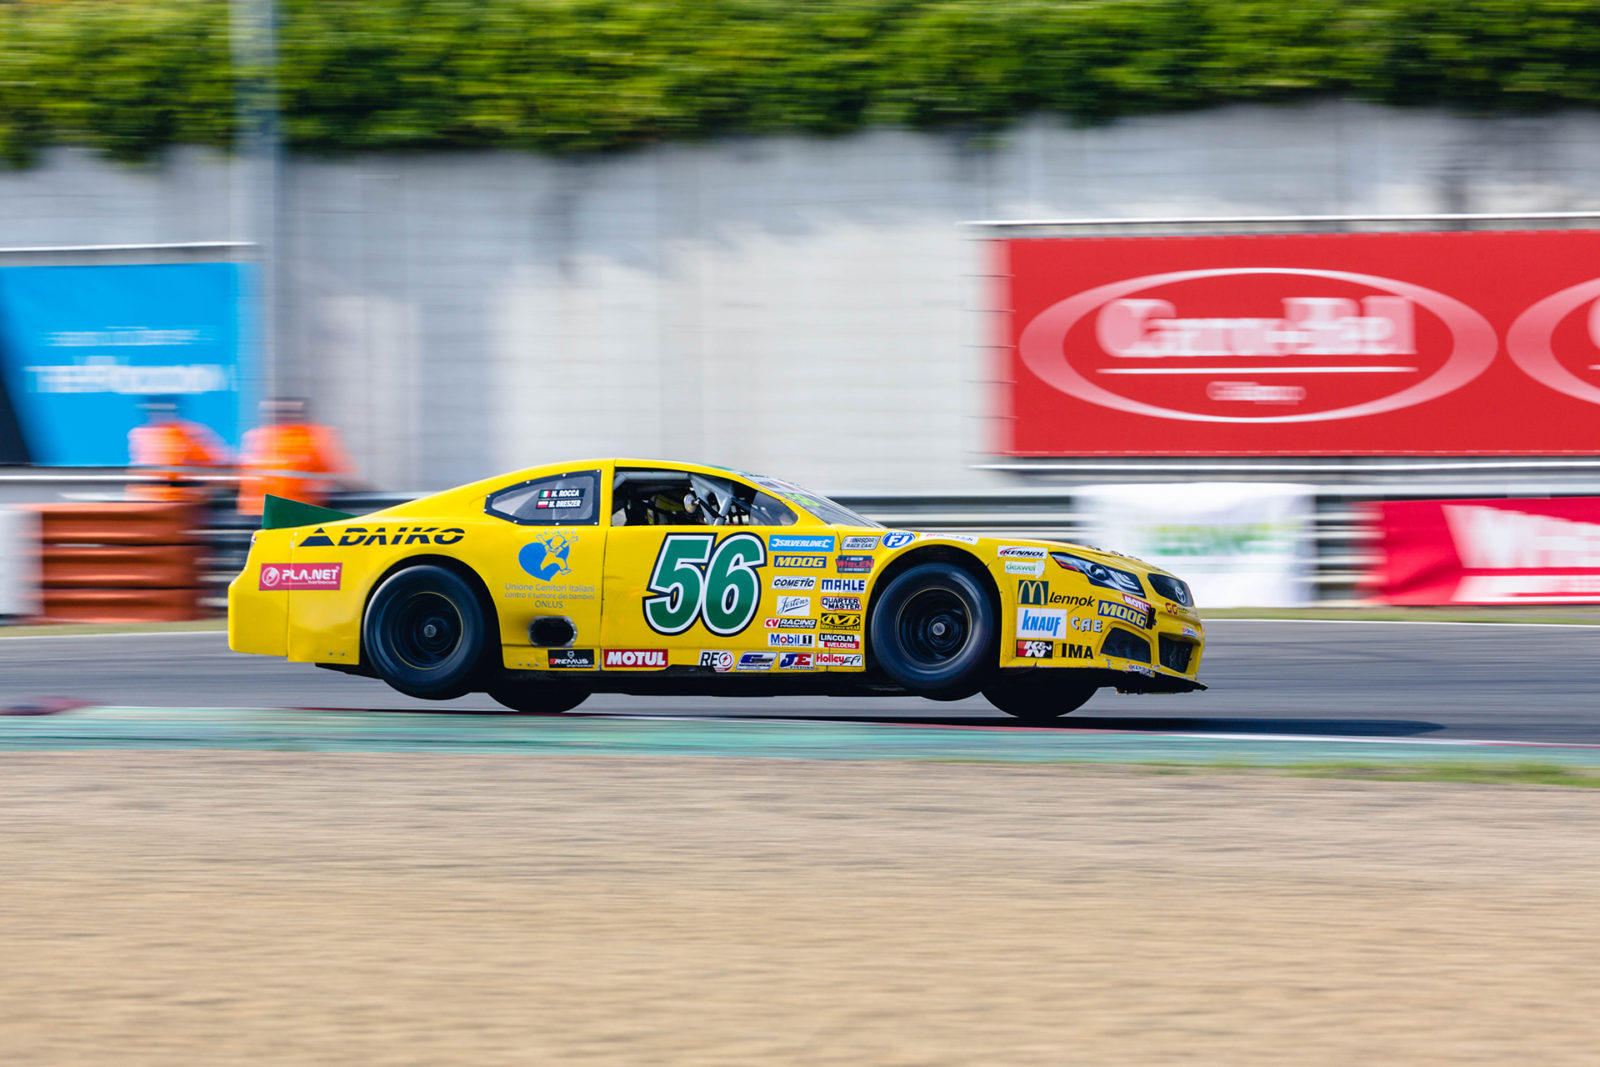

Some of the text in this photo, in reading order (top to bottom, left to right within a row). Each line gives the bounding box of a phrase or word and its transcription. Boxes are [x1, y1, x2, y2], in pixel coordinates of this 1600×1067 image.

[559, 489, 580, 497] ROCCA
[556, 500, 581, 508] DRESZER
[338, 527, 465, 546] DAIKO
[886, 535, 910, 547] FJ
[775, 538, 825, 548] SILVERLINE
[1002, 549, 1044, 557] KENNOL
[776, 556, 825, 567] MOOG
[836, 558, 875, 569] WHELEN
[504, 583, 595, 592] Unione Genitori Italiani
[642, 532, 767, 636] 56
[773, 578, 815, 587] COMETIC
[821, 579, 865, 591] MAHLE
[569, 592, 595, 600] bambini
[821, 597, 860, 606] QUARTER
[1049, 592, 1096, 608] lennok
[535, 600, 564, 609] ONLUS
[1099, 602, 1146, 627] MOOG
[765, 619, 780, 627] CV
[1070, 616, 1104, 633] CAE
[770, 633, 800, 644] Mobil
[803, 634, 812, 645] 1
[820, 633, 853, 642] LINCOLN
[826, 641, 857, 649] WELDERS
[1023, 640, 1053, 658] K&N
[1062, 643, 1094, 659] IMA
[606, 651, 666, 666] MOTUL
[780, 653, 812, 668] JE
[816, 653, 845, 666] Holley
